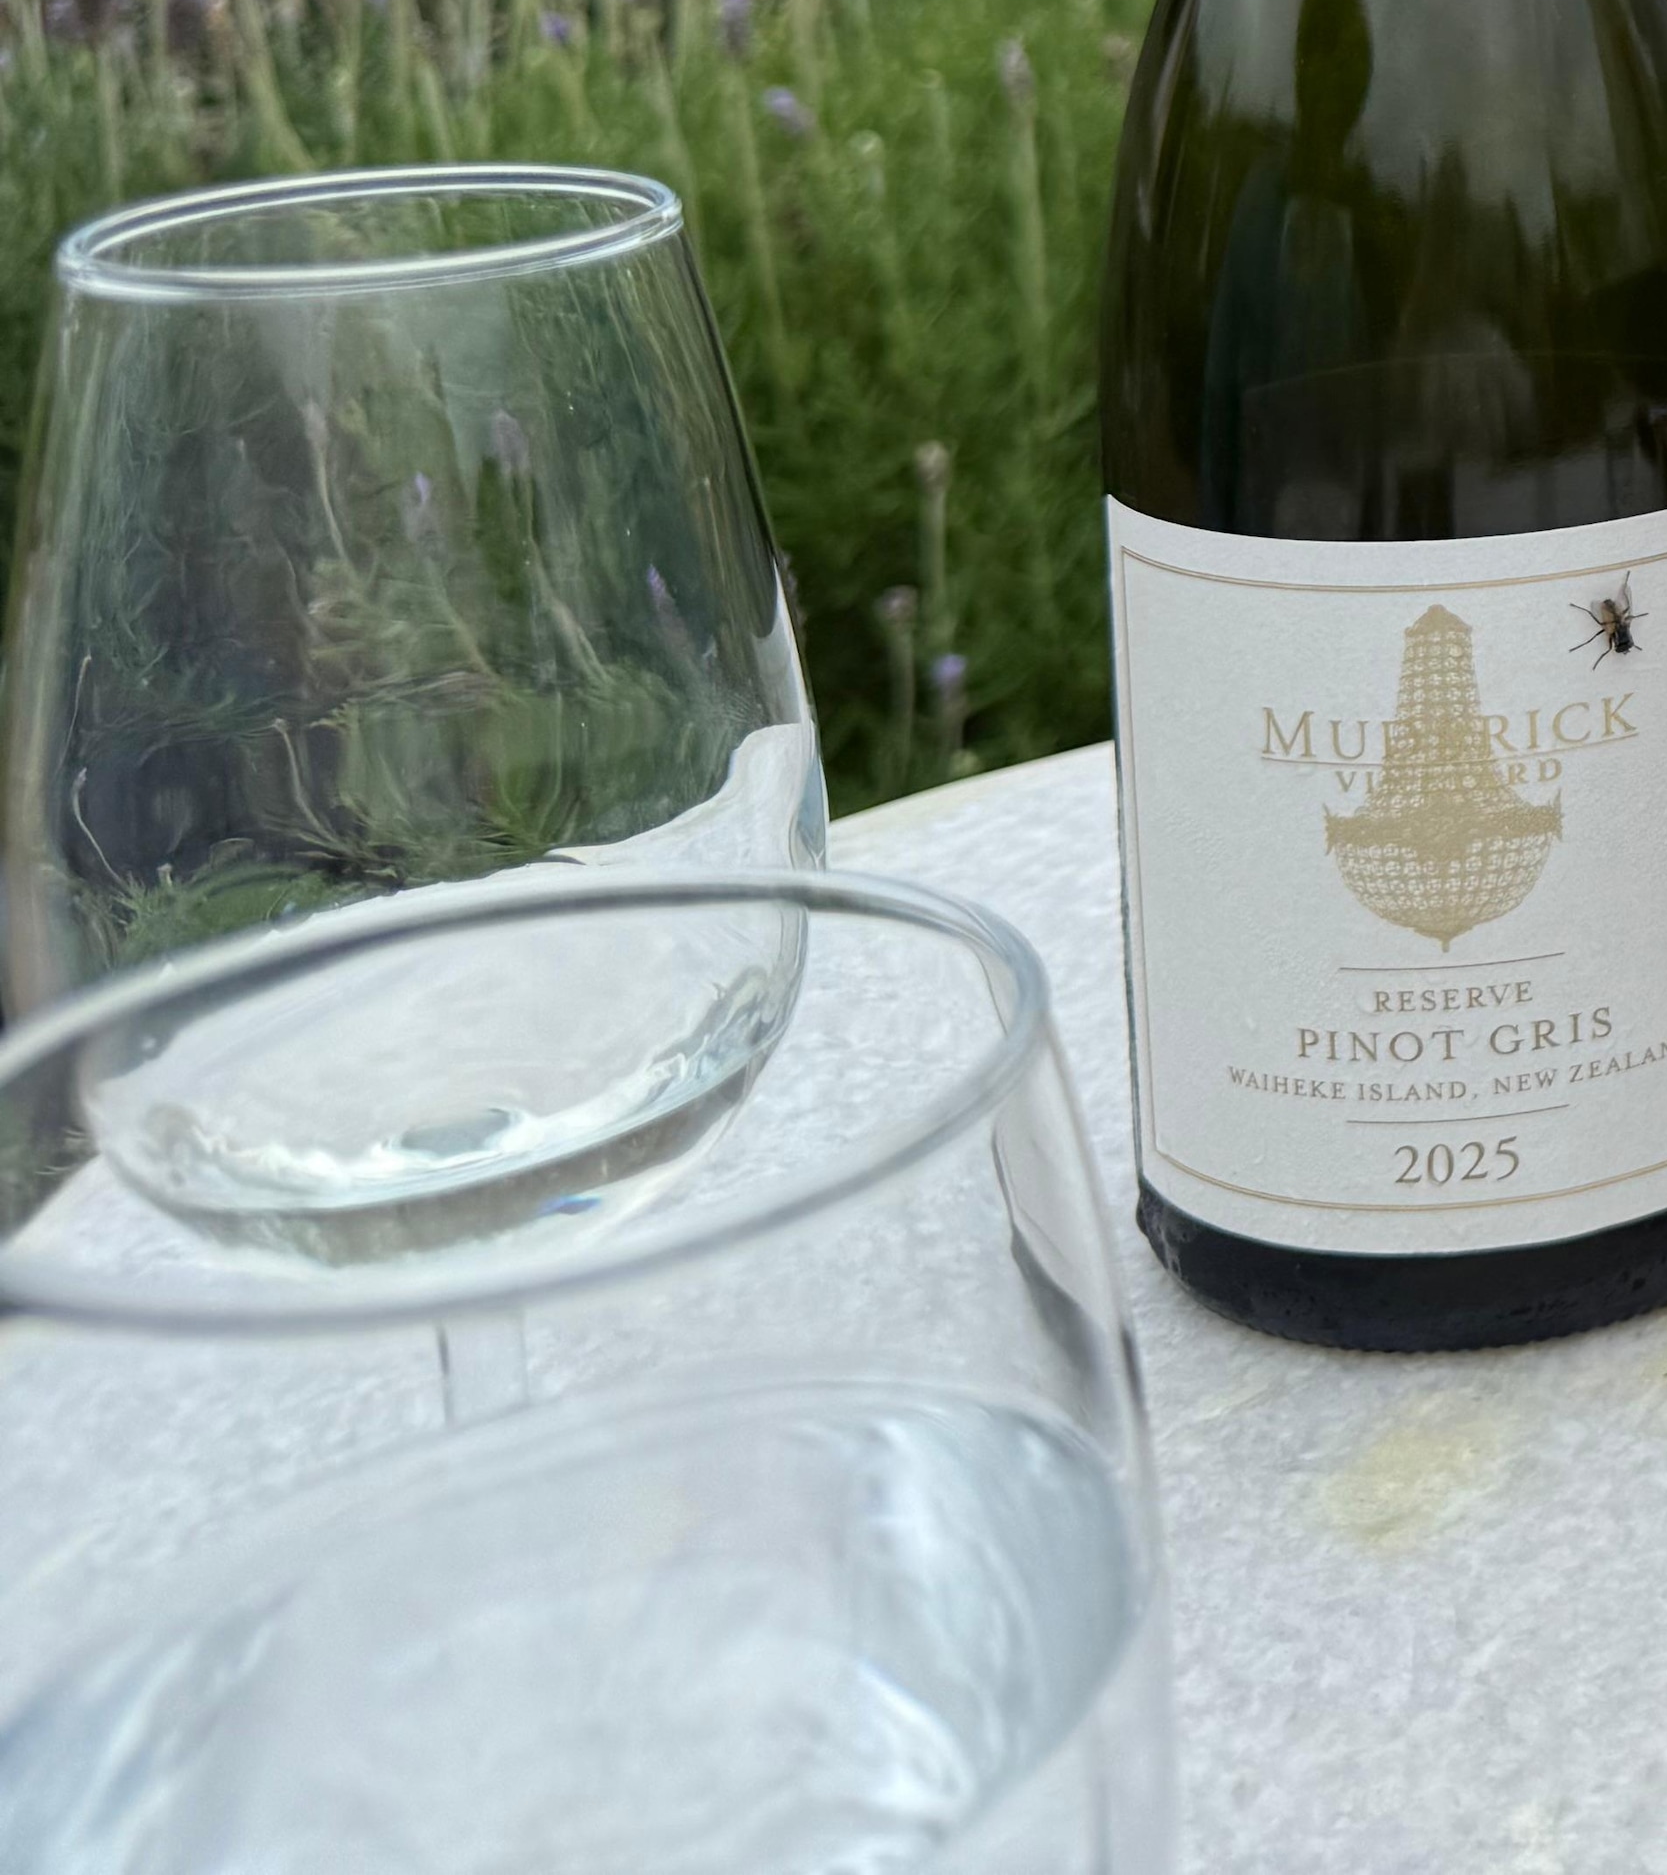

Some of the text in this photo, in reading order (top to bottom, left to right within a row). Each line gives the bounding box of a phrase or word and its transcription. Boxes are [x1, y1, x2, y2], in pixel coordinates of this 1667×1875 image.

[1261, 692, 1638, 761] MURICK
[1373, 981, 1534, 1013] RESERVE
[1297, 1007, 1613, 1063] PINOT GRIS
[1228, 1066, 1347, 1101] WAIHEKE
[1358, 1081, 1479, 1102] ISLAND,
[1493, 1068, 1558, 1096] NEW
[1394, 1136, 1521, 1185] 2025
